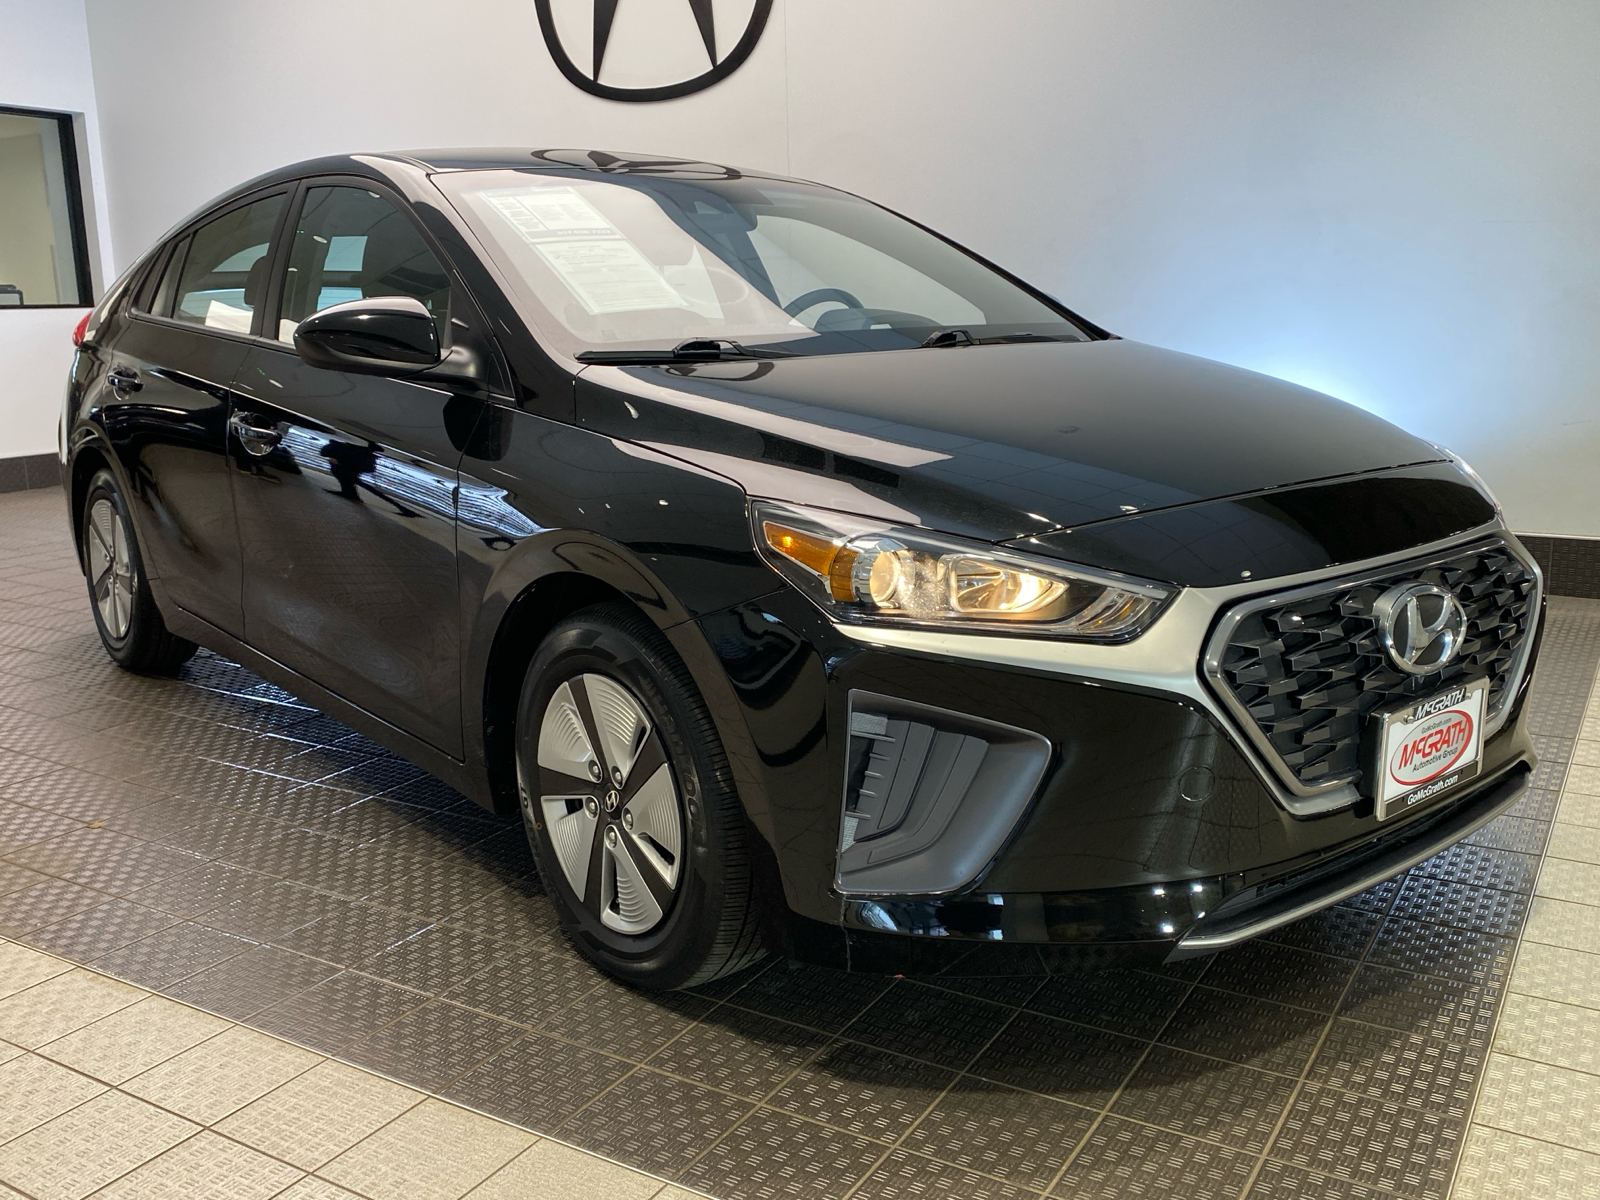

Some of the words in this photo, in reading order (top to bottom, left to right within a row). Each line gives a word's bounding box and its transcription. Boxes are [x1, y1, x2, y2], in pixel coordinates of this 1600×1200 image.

[1421, 717, 1453, 735] GoMcGrath.com
[1411, 753, 1442, 773] Automotive
[1442, 746, 1459, 759] Group
[1407, 774, 1459, 805] GoMcGrath.com
